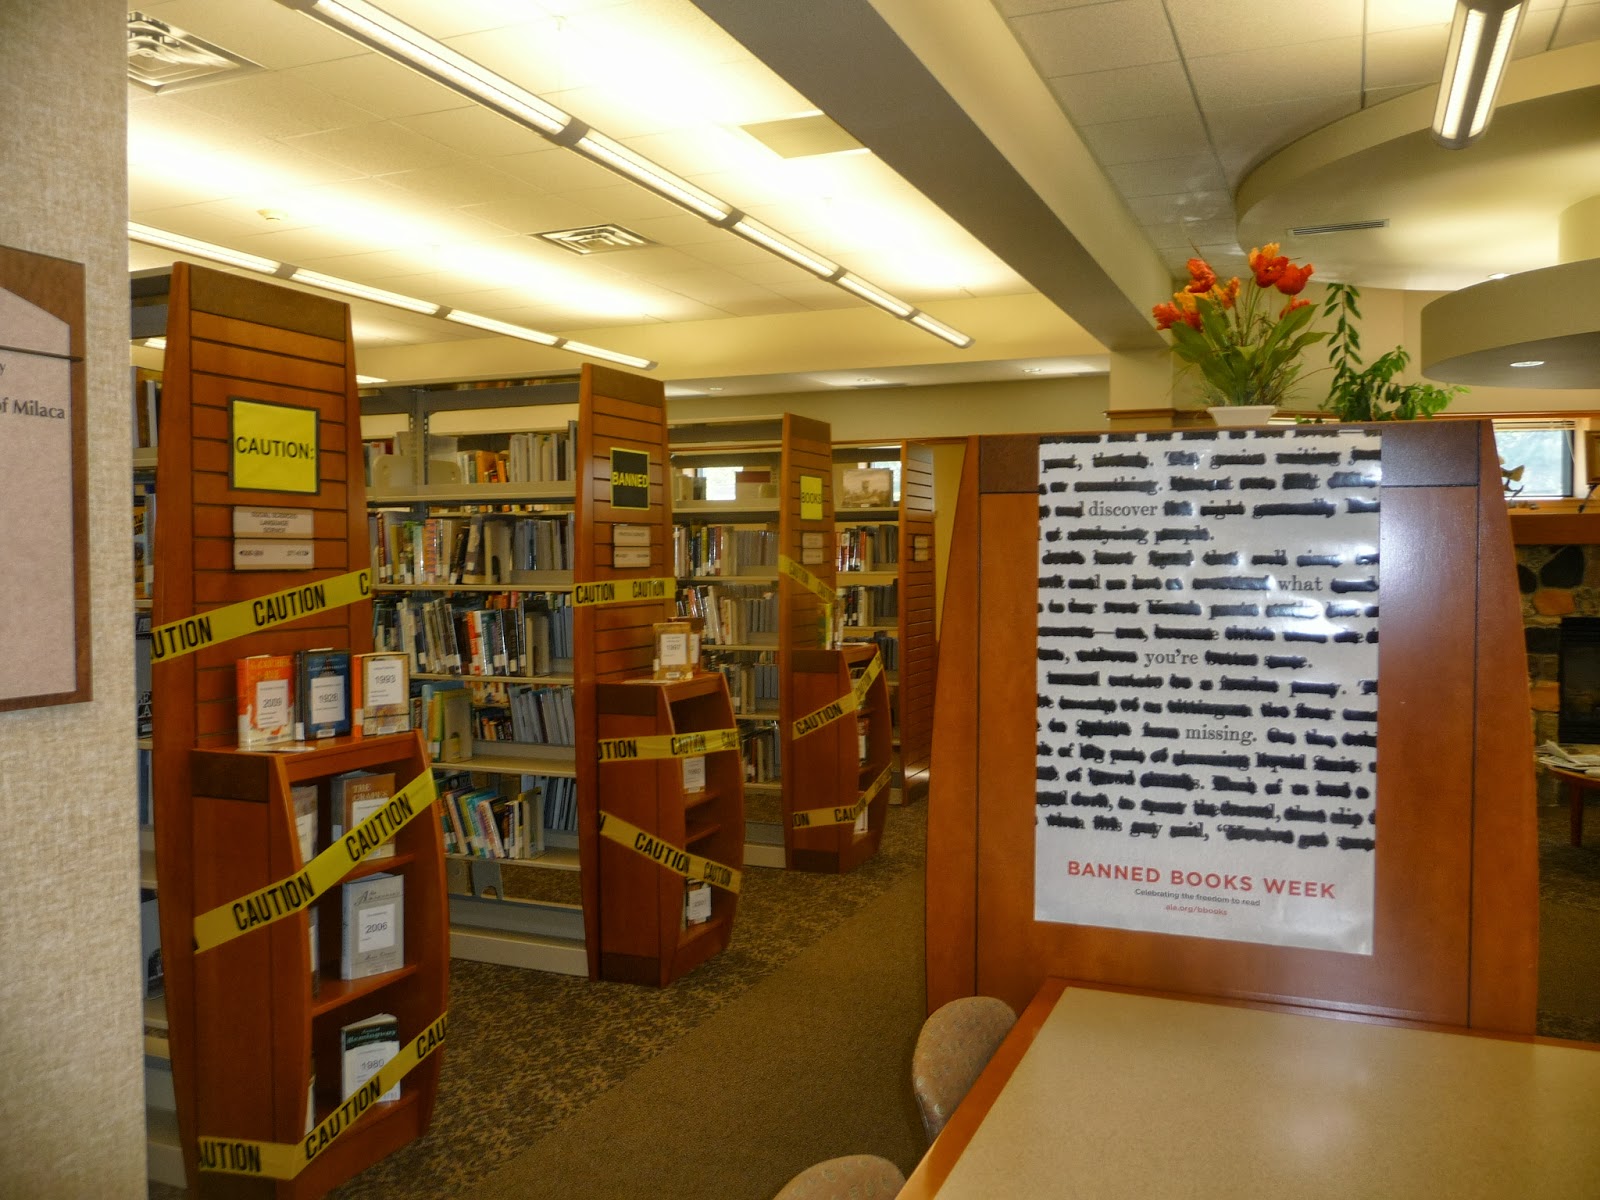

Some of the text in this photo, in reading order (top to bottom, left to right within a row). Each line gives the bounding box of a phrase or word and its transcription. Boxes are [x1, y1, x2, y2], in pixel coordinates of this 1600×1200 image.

[0, 397, 65, 419] f Milaca
[236, 436, 315, 460] CAUTION:
[612, 471, 649, 488] BANNED
[801, 491, 822, 505] BOOKS
[1088, 500, 1158, 517] discover
[575, 580, 665, 604] CAUTION CAUTION
[1278, 575, 1324, 592] what
[253, 583, 326, 627] CAUTION
[1143, 644, 1199, 668] you're
[795, 702, 843, 735] CAUTION
[1185, 723, 1257, 746] missing.
[232, 793, 414, 931] CAUTION CAUTION
[634, 832, 733, 887] CAUTION CAUTION
[1067, 860, 1336, 899] BANNED BOOKS WEEK
[1135, 888, 1261, 907] Celebrating the freedom to read
[1165, 903, 1228, 916] ala.org/bbooks
[365, 921, 388, 934] 2006
[304, 1076, 381, 1161] CAUTION
[416, 1016, 447, 1060] CAU
